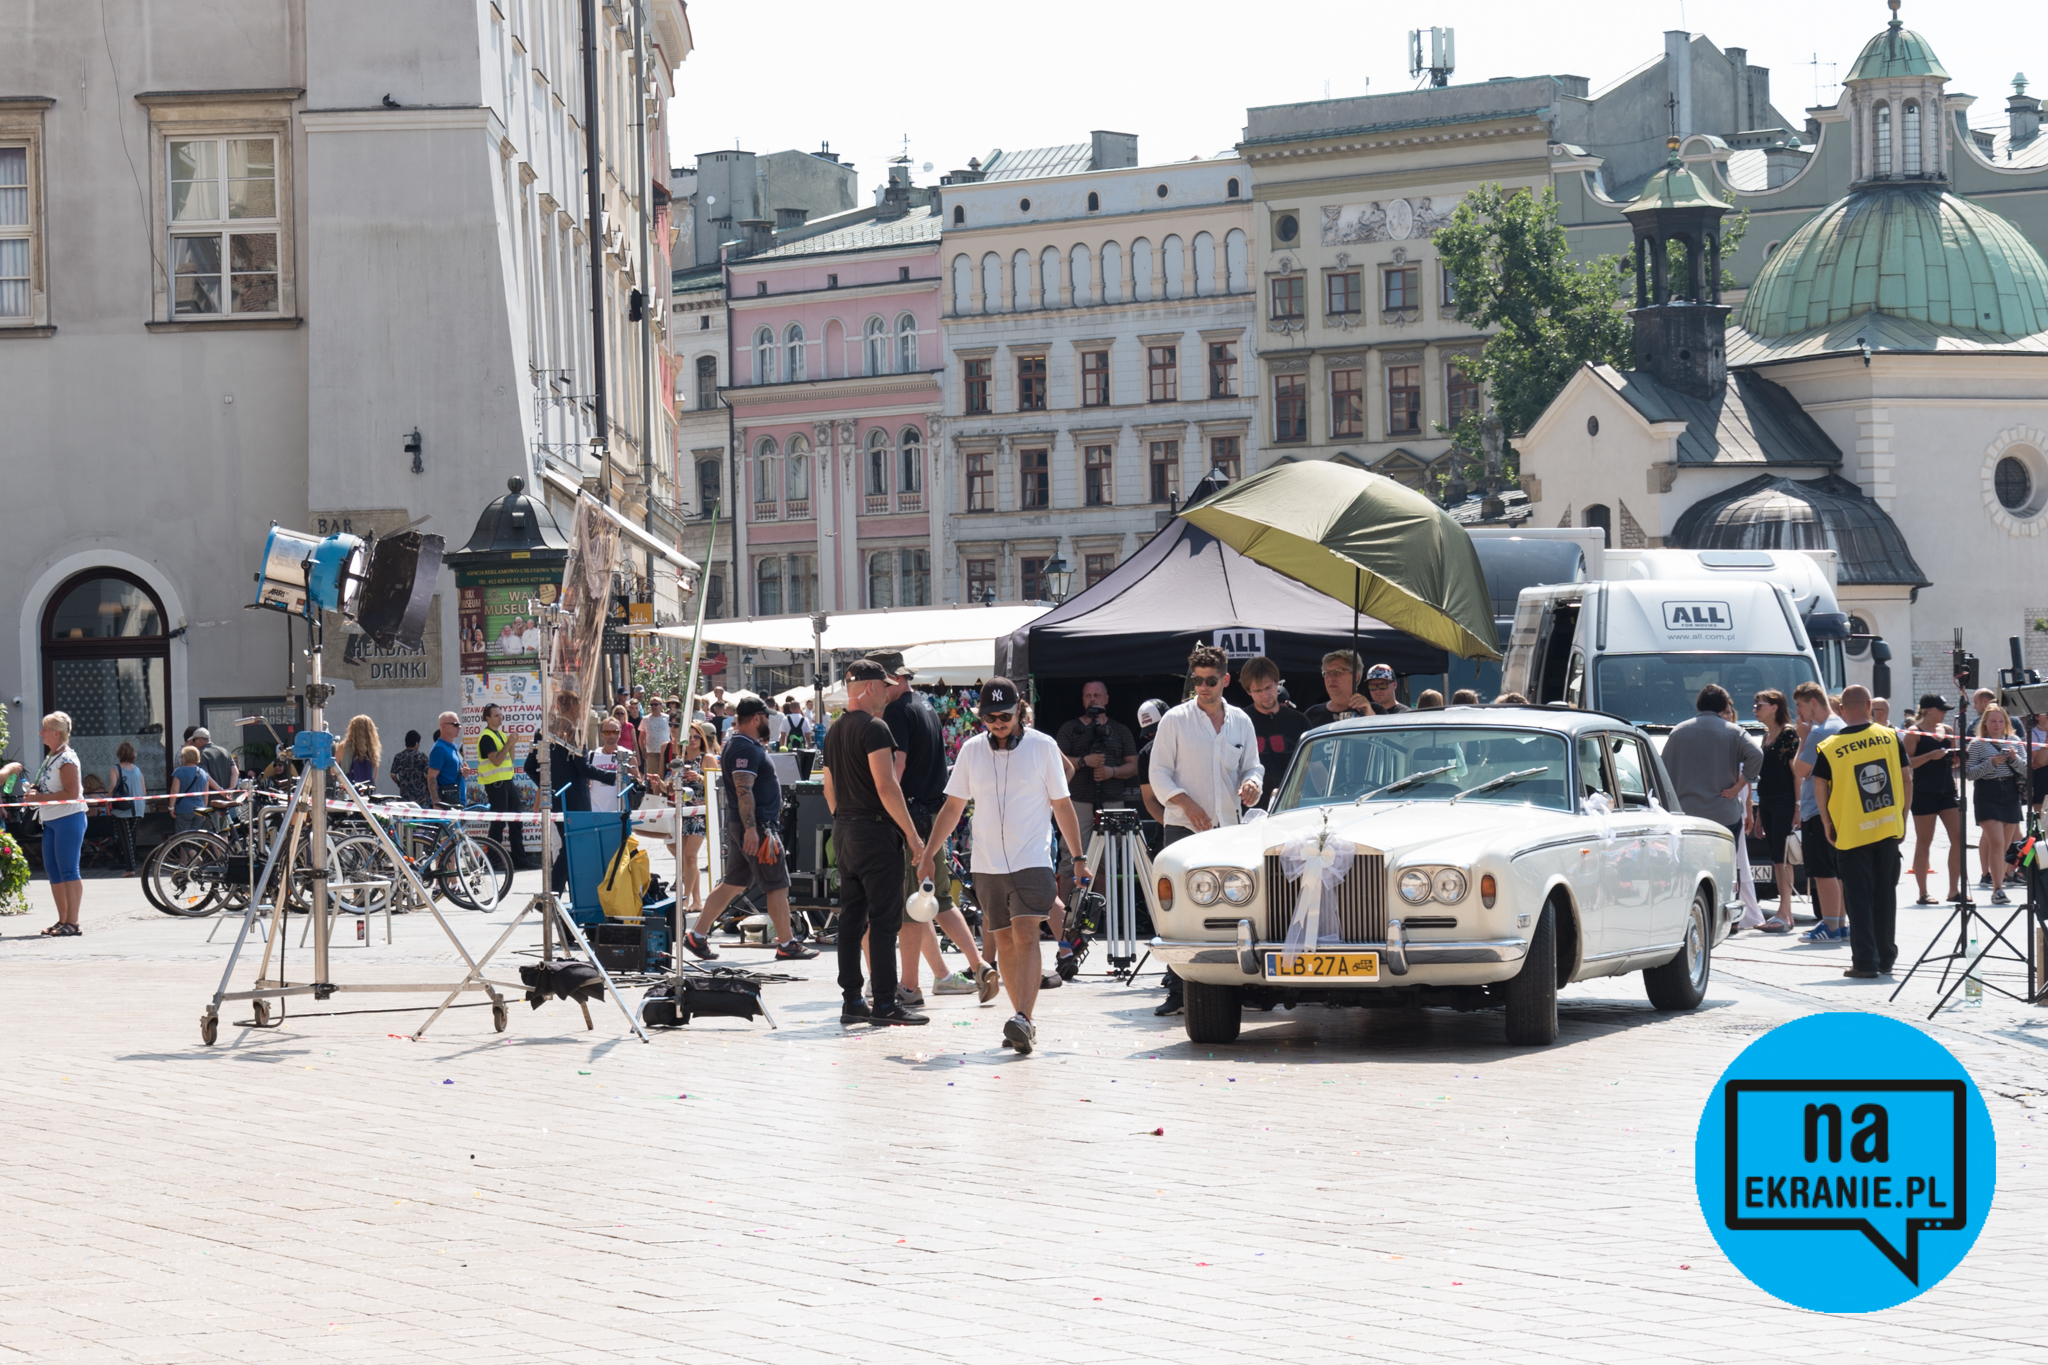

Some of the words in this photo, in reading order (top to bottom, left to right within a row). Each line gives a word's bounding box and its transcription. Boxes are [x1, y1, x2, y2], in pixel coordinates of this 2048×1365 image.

[318, 519, 353, 534] BAR
[508, 591, 537, 602] WAX
[484, 603, 527, 616] MUSEU
[1672, 607, 1725, 623] ALL
[1220, 633, 1261, 652] ALL
[1667, 633, 1735, 641] www.all.com.pl
[371, 662, 428, 680] DRINKI
[502, 712, 543, 721] BOTÓW
[502, 724, 534, 733] LEGO
[1835, 735, 1891, 759] STEWARD
[1865, 793, 1892, 812] 046
[1313, 956, 1349, 975] 27A
